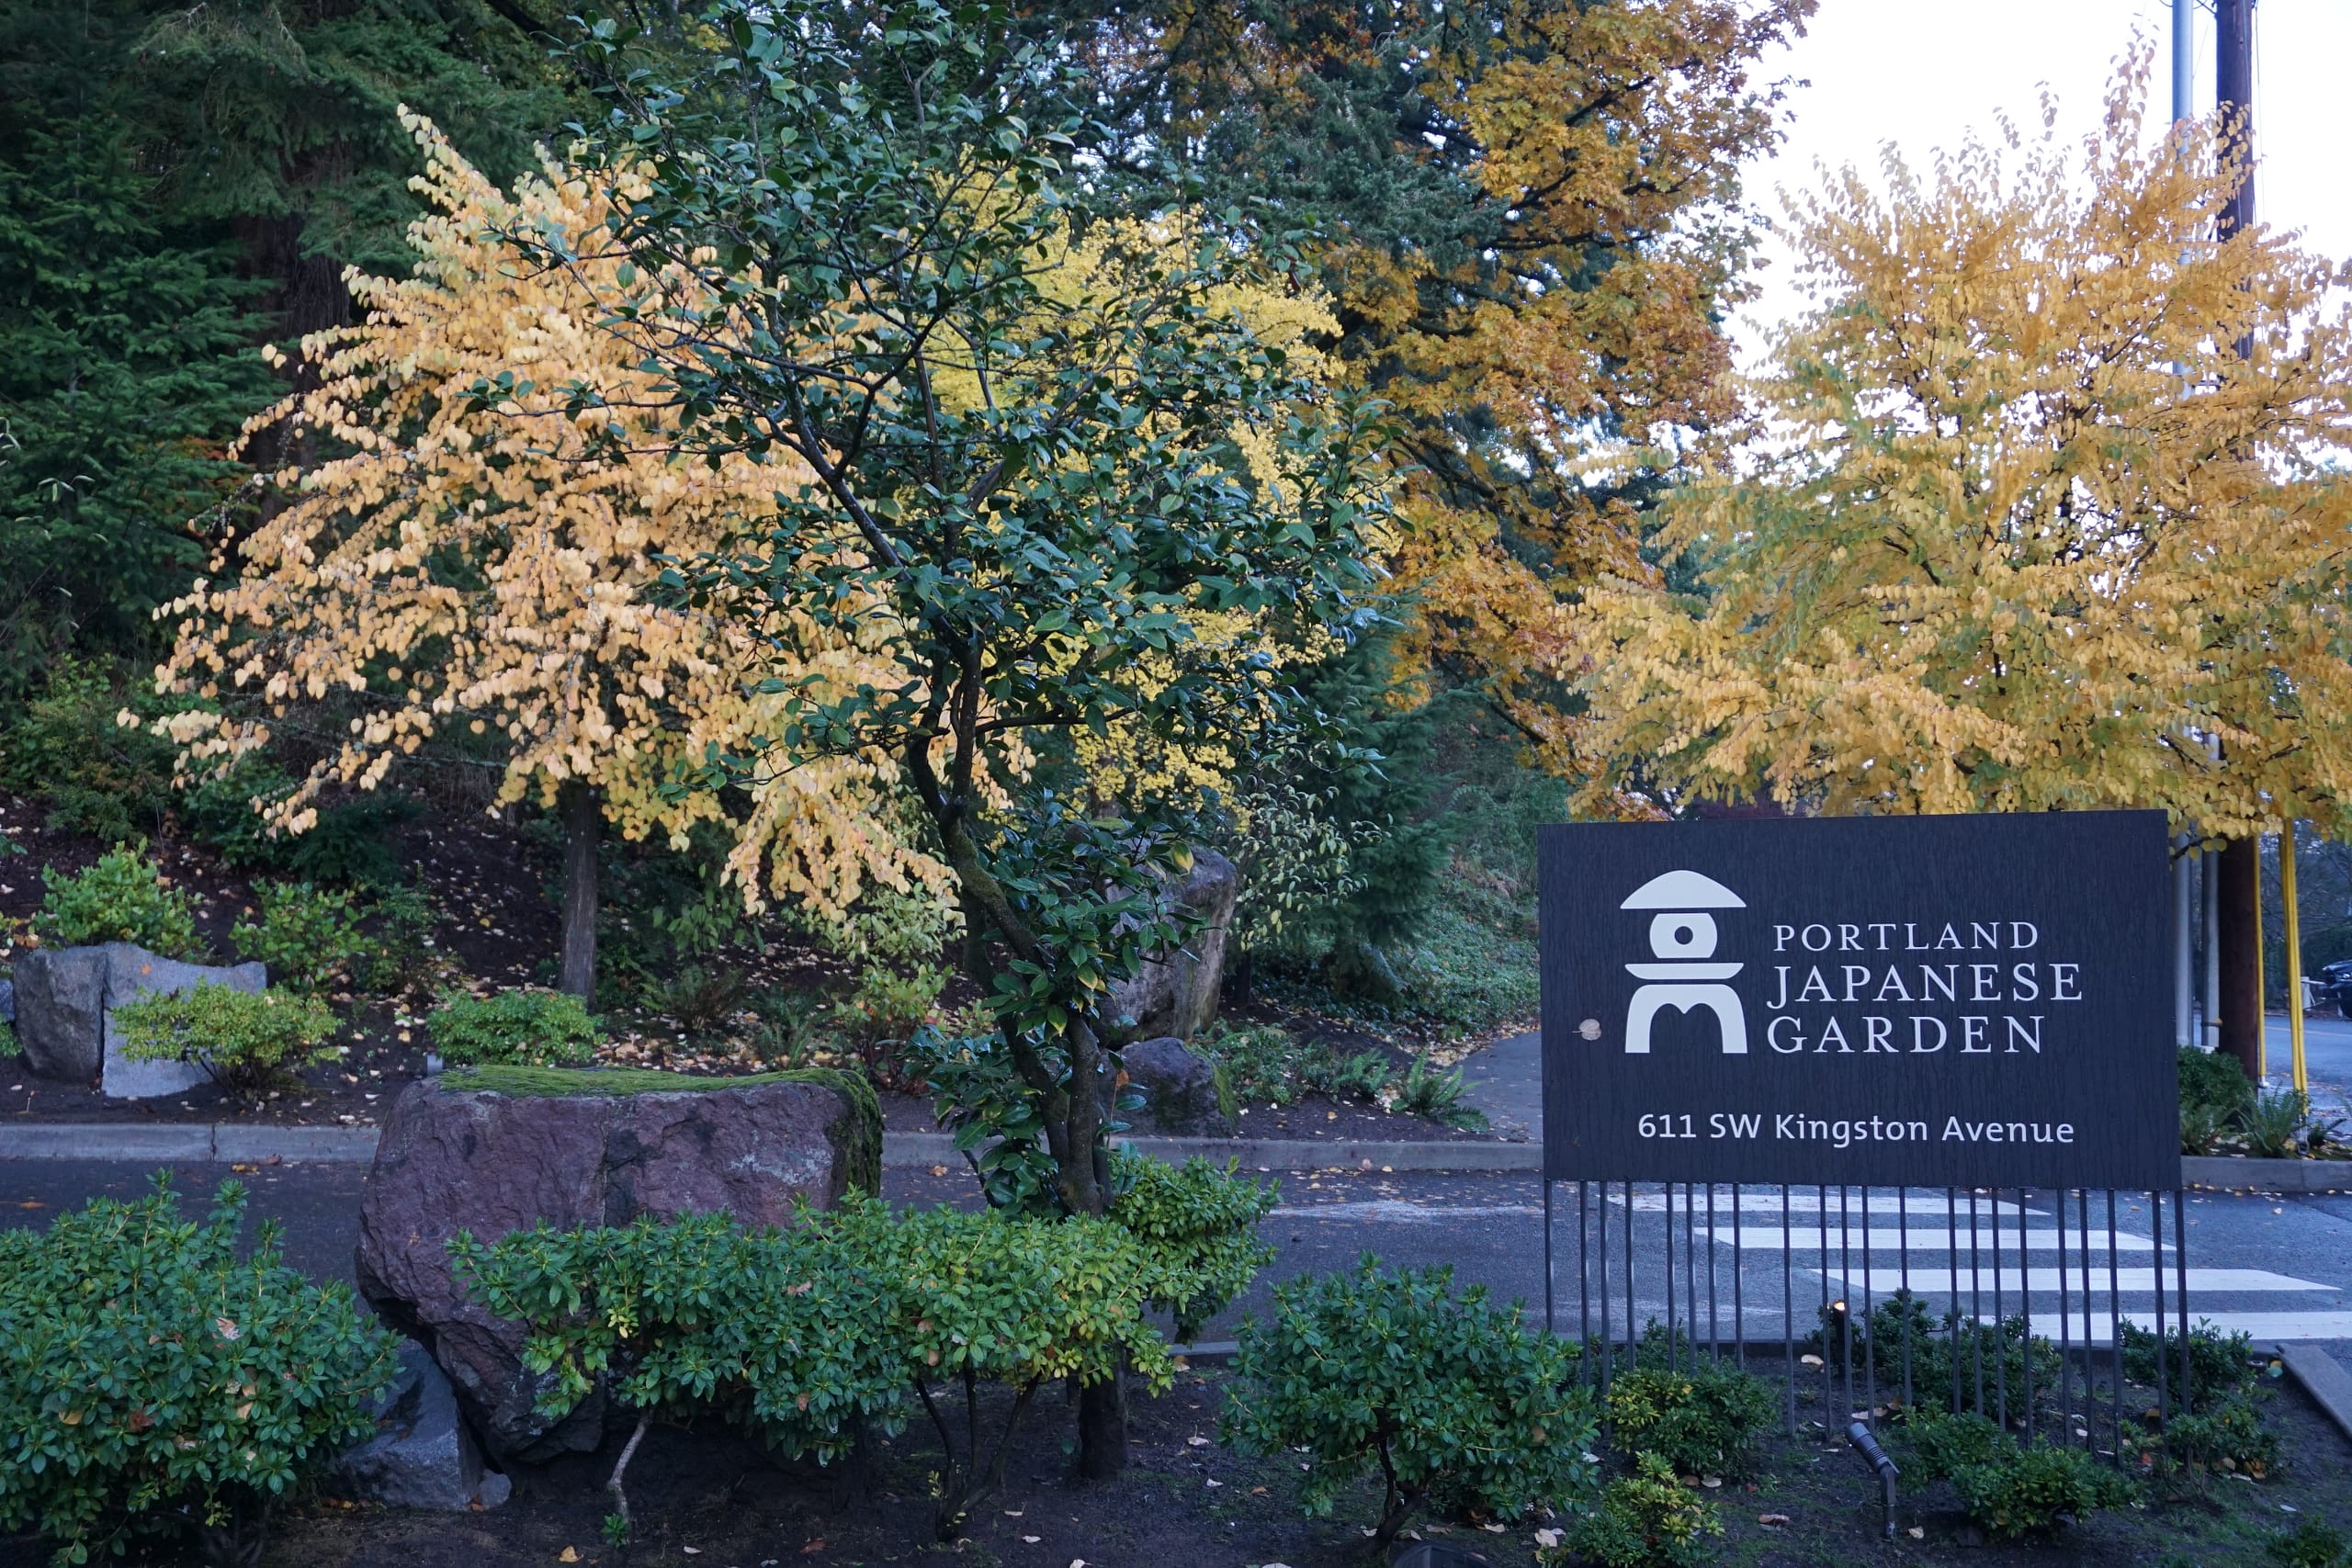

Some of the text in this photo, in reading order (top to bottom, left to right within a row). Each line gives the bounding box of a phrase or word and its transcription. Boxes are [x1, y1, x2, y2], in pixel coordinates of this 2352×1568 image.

[1773, 921, 2038, 952] PORTLAND
[1767, 962, 2082, 1010] JAPANESE
[1767, 1015, 2044, 1055] GARDEN
[1638, 1113, 2075, 1148] 611 SW Kingston Avenue
